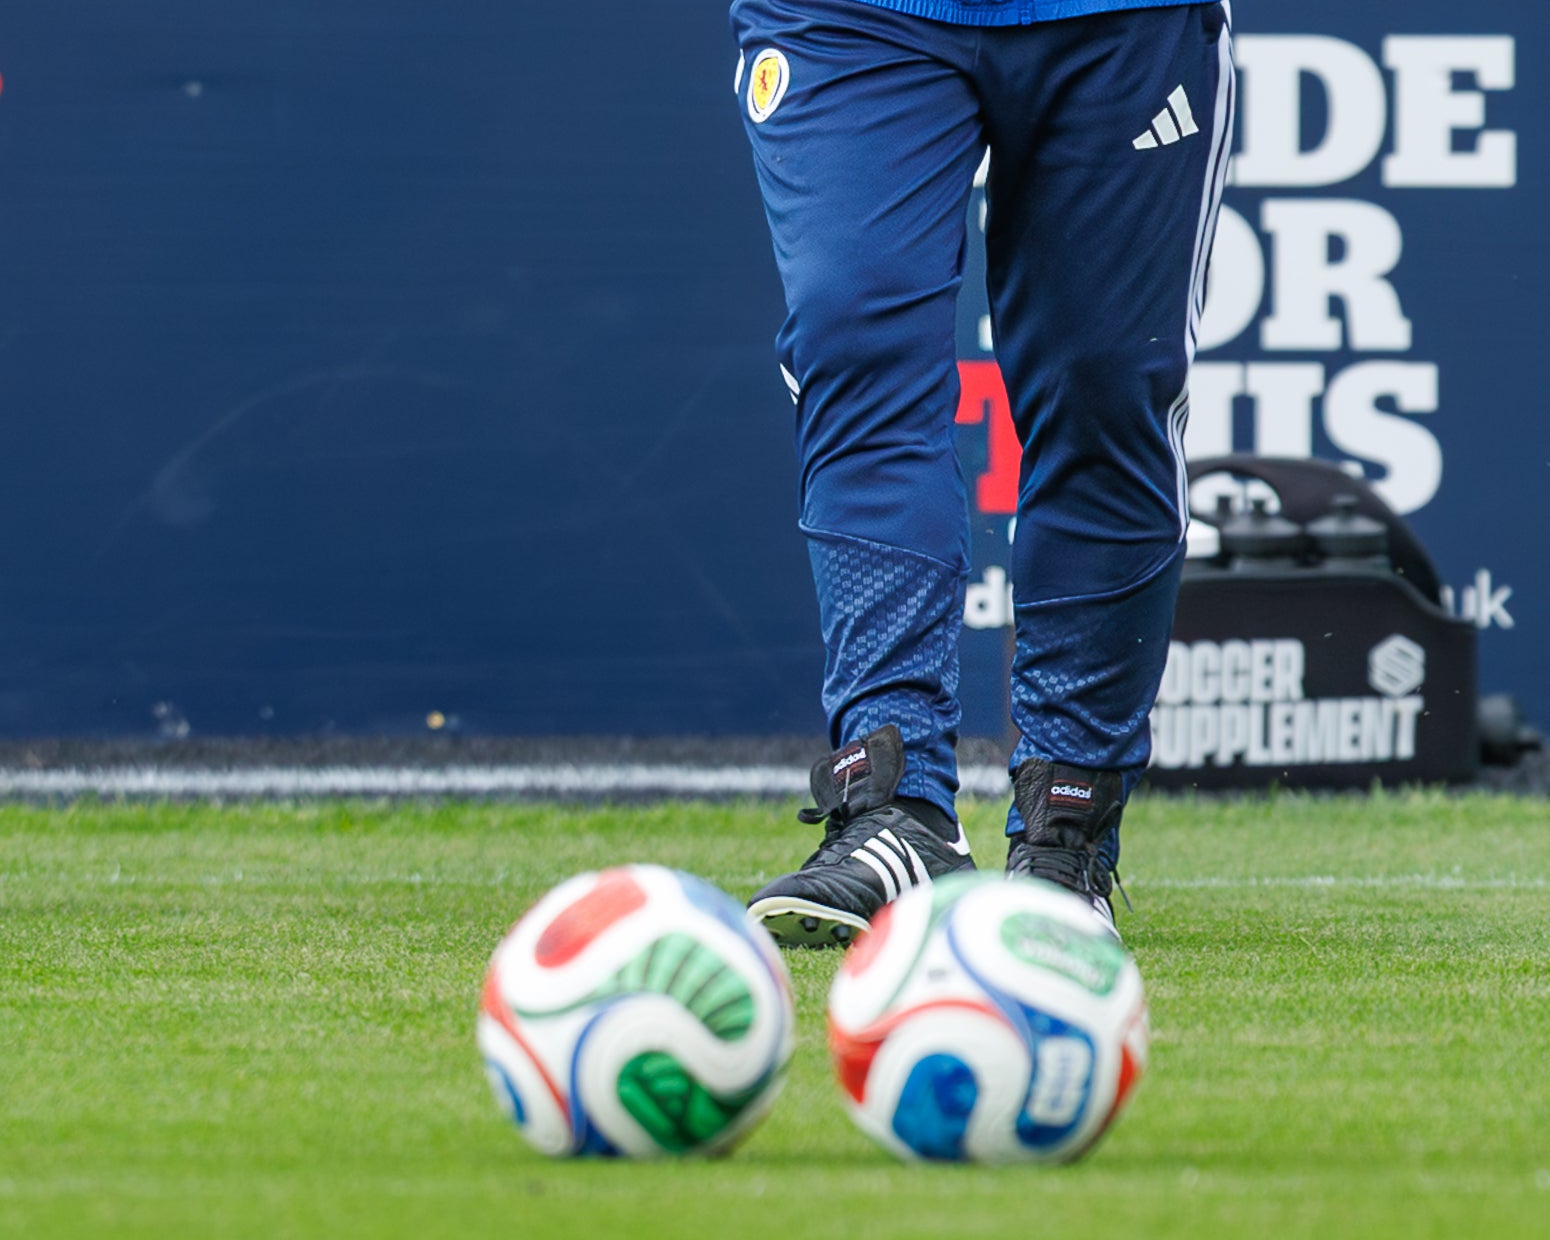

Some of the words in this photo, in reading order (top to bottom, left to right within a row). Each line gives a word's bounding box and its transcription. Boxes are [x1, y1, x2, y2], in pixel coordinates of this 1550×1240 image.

[1155, 639, 1304, 705] OCCER
[1147, 695, 1425, 769] UPPLEMENT
[1050, 785, 1092, 799] adidas
